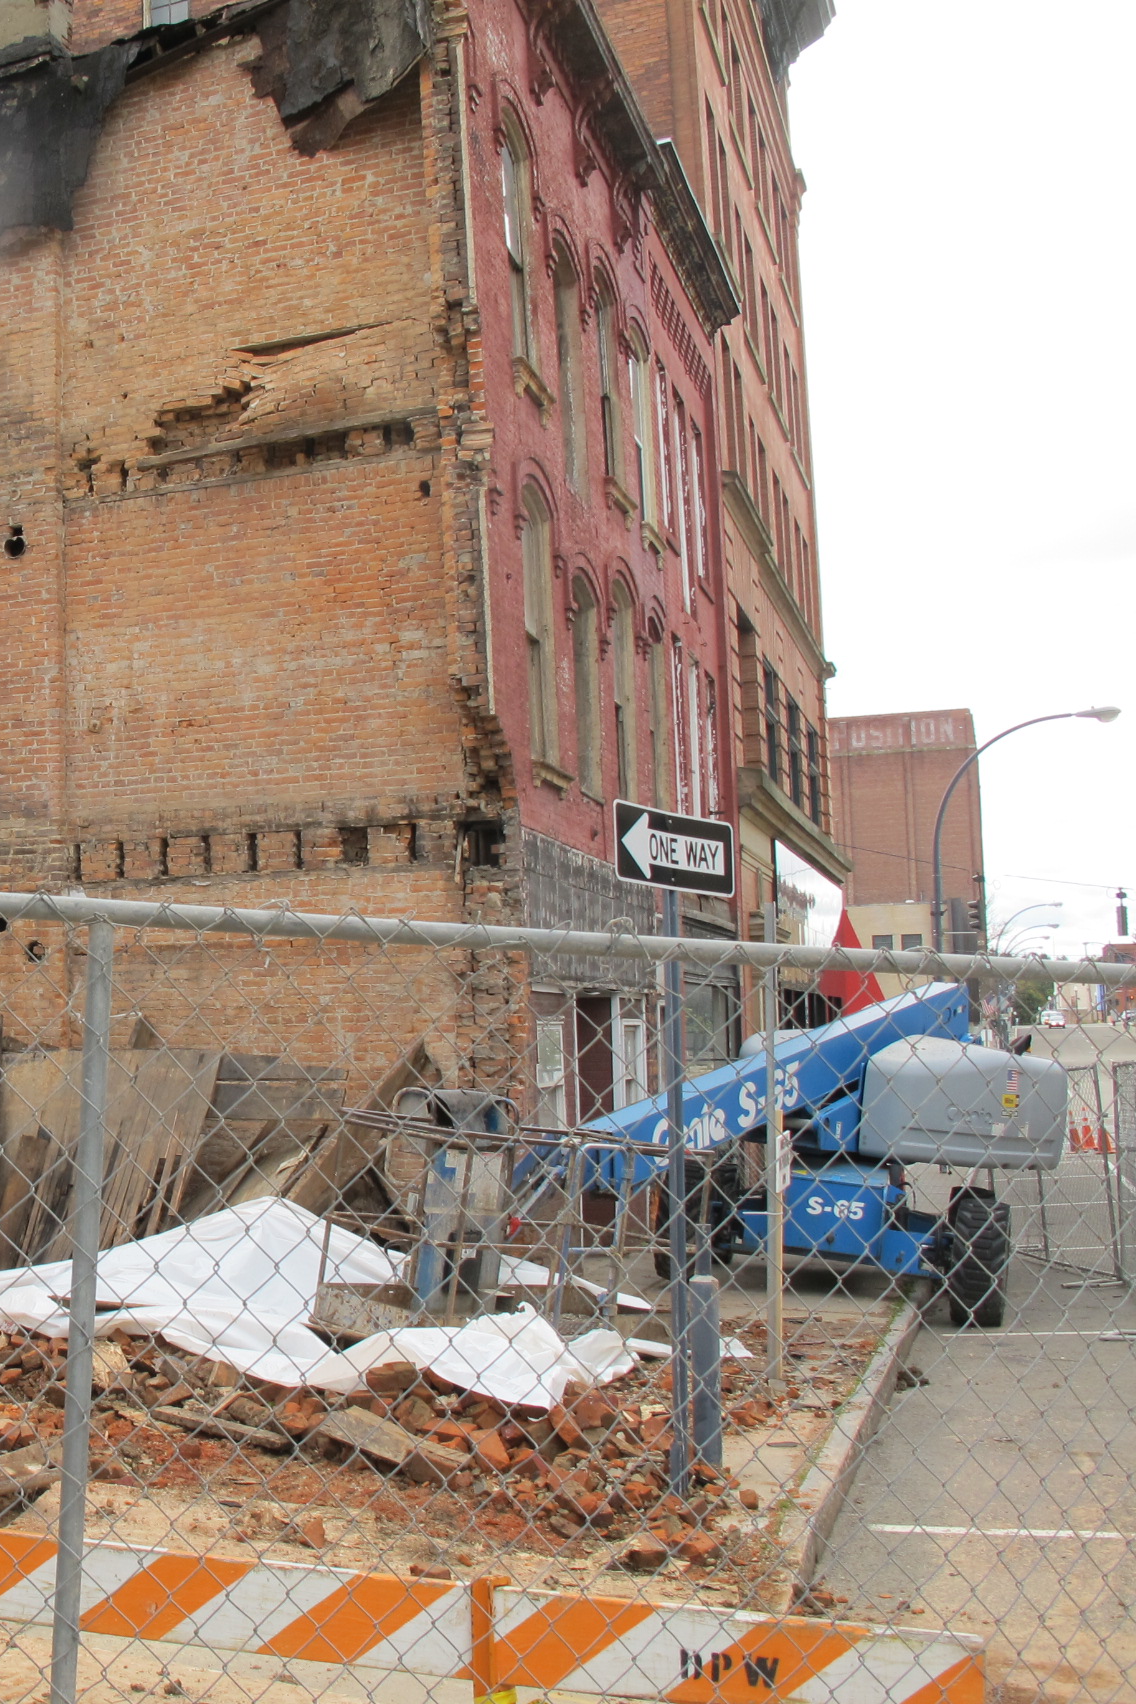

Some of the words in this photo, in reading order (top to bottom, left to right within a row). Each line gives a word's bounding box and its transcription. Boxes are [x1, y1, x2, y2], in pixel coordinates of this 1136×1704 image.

[649, 833, 679, 865] ONE
[684, 840, 719, 871] WAY
[805, 1196, 865, 1220] S-65
[680, 1648, 779, 1688] DPW
